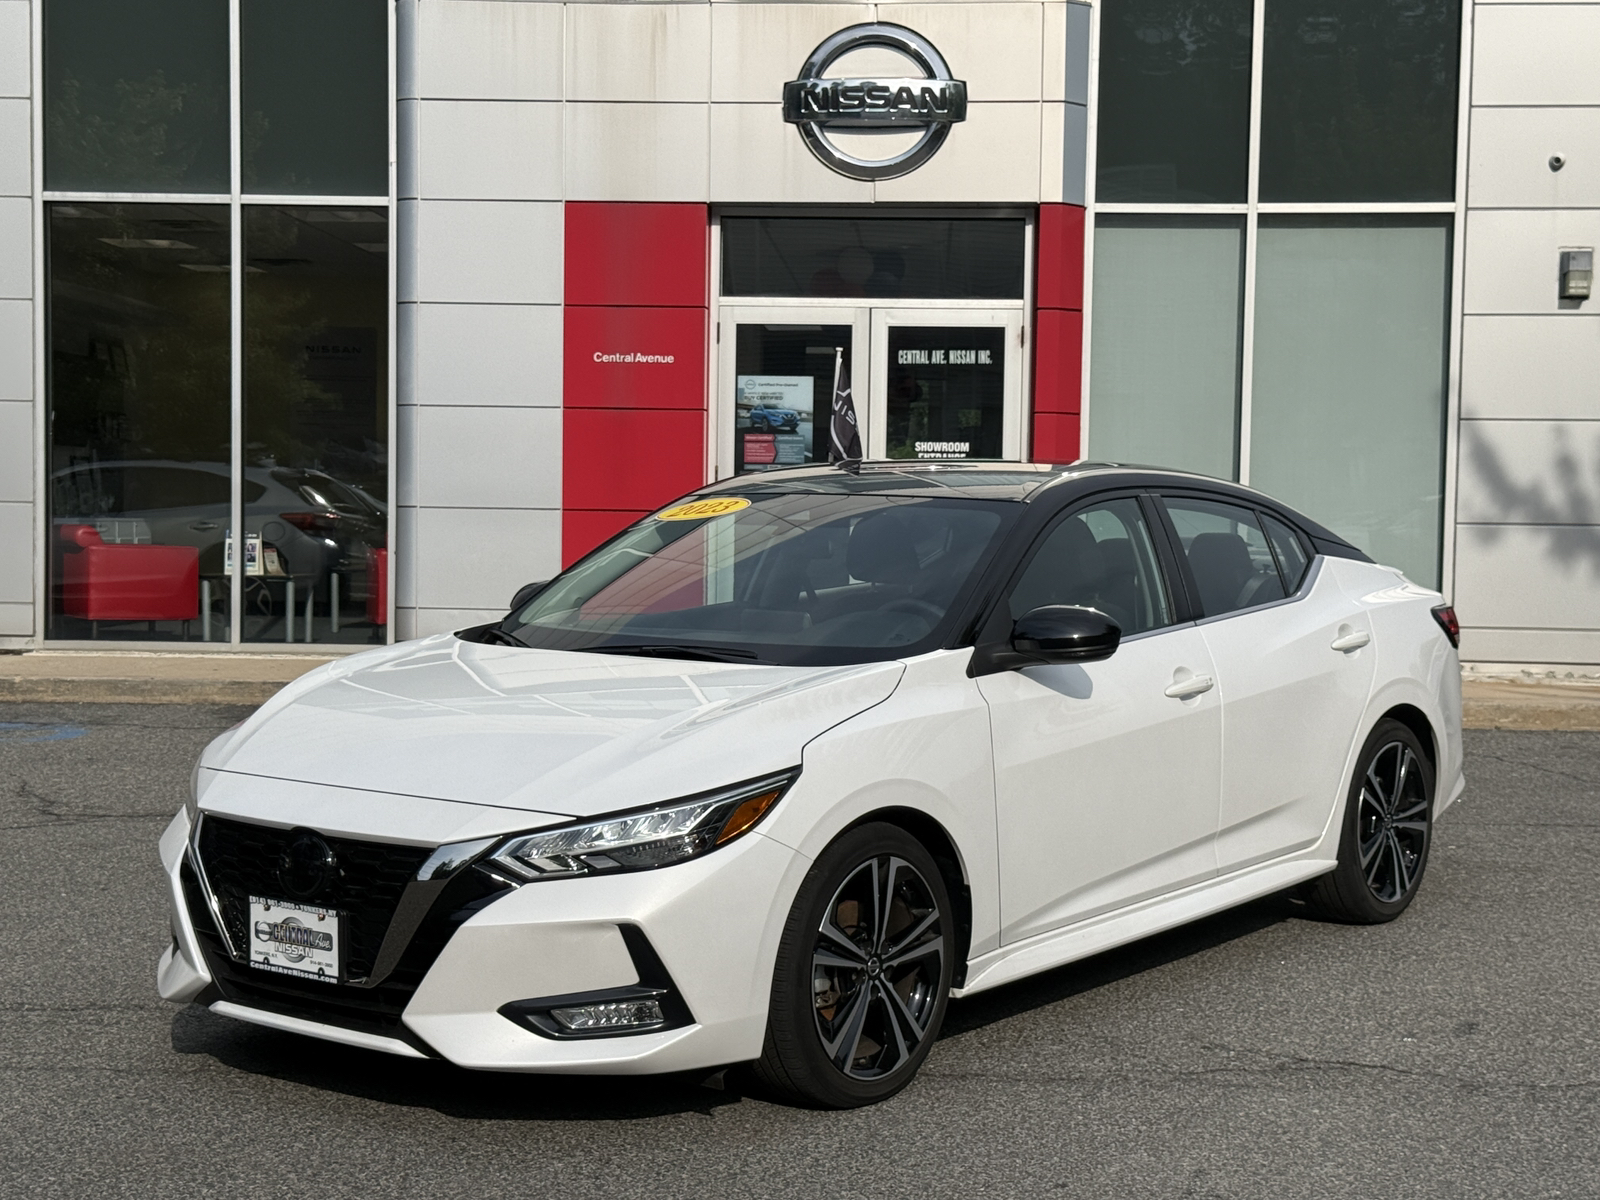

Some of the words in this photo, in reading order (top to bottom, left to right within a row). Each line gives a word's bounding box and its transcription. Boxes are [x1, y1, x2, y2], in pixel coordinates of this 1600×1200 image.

[801, 86, 949, 113] NISSAN
[305, 345, 362, 353] NISSAN
[593, 351, 634, 363] Central
[635, 352, 675, 364] Avenue
[898, 350, 929, 364] CENTRAL
[931, 350, 947, 364] AVE.
[949, 350, 976, 364] NISSAN
[977, 350, 993, 364] INC.
[914, 441, 970, 452] SHOWROOM
[666, 500, 740, 517] 2023
[273, 922, 315, 947] CENTRAL
[274, 941, 313, 958] NISSAN
[250, 961, 337, 984] CentralAveNissan.com
